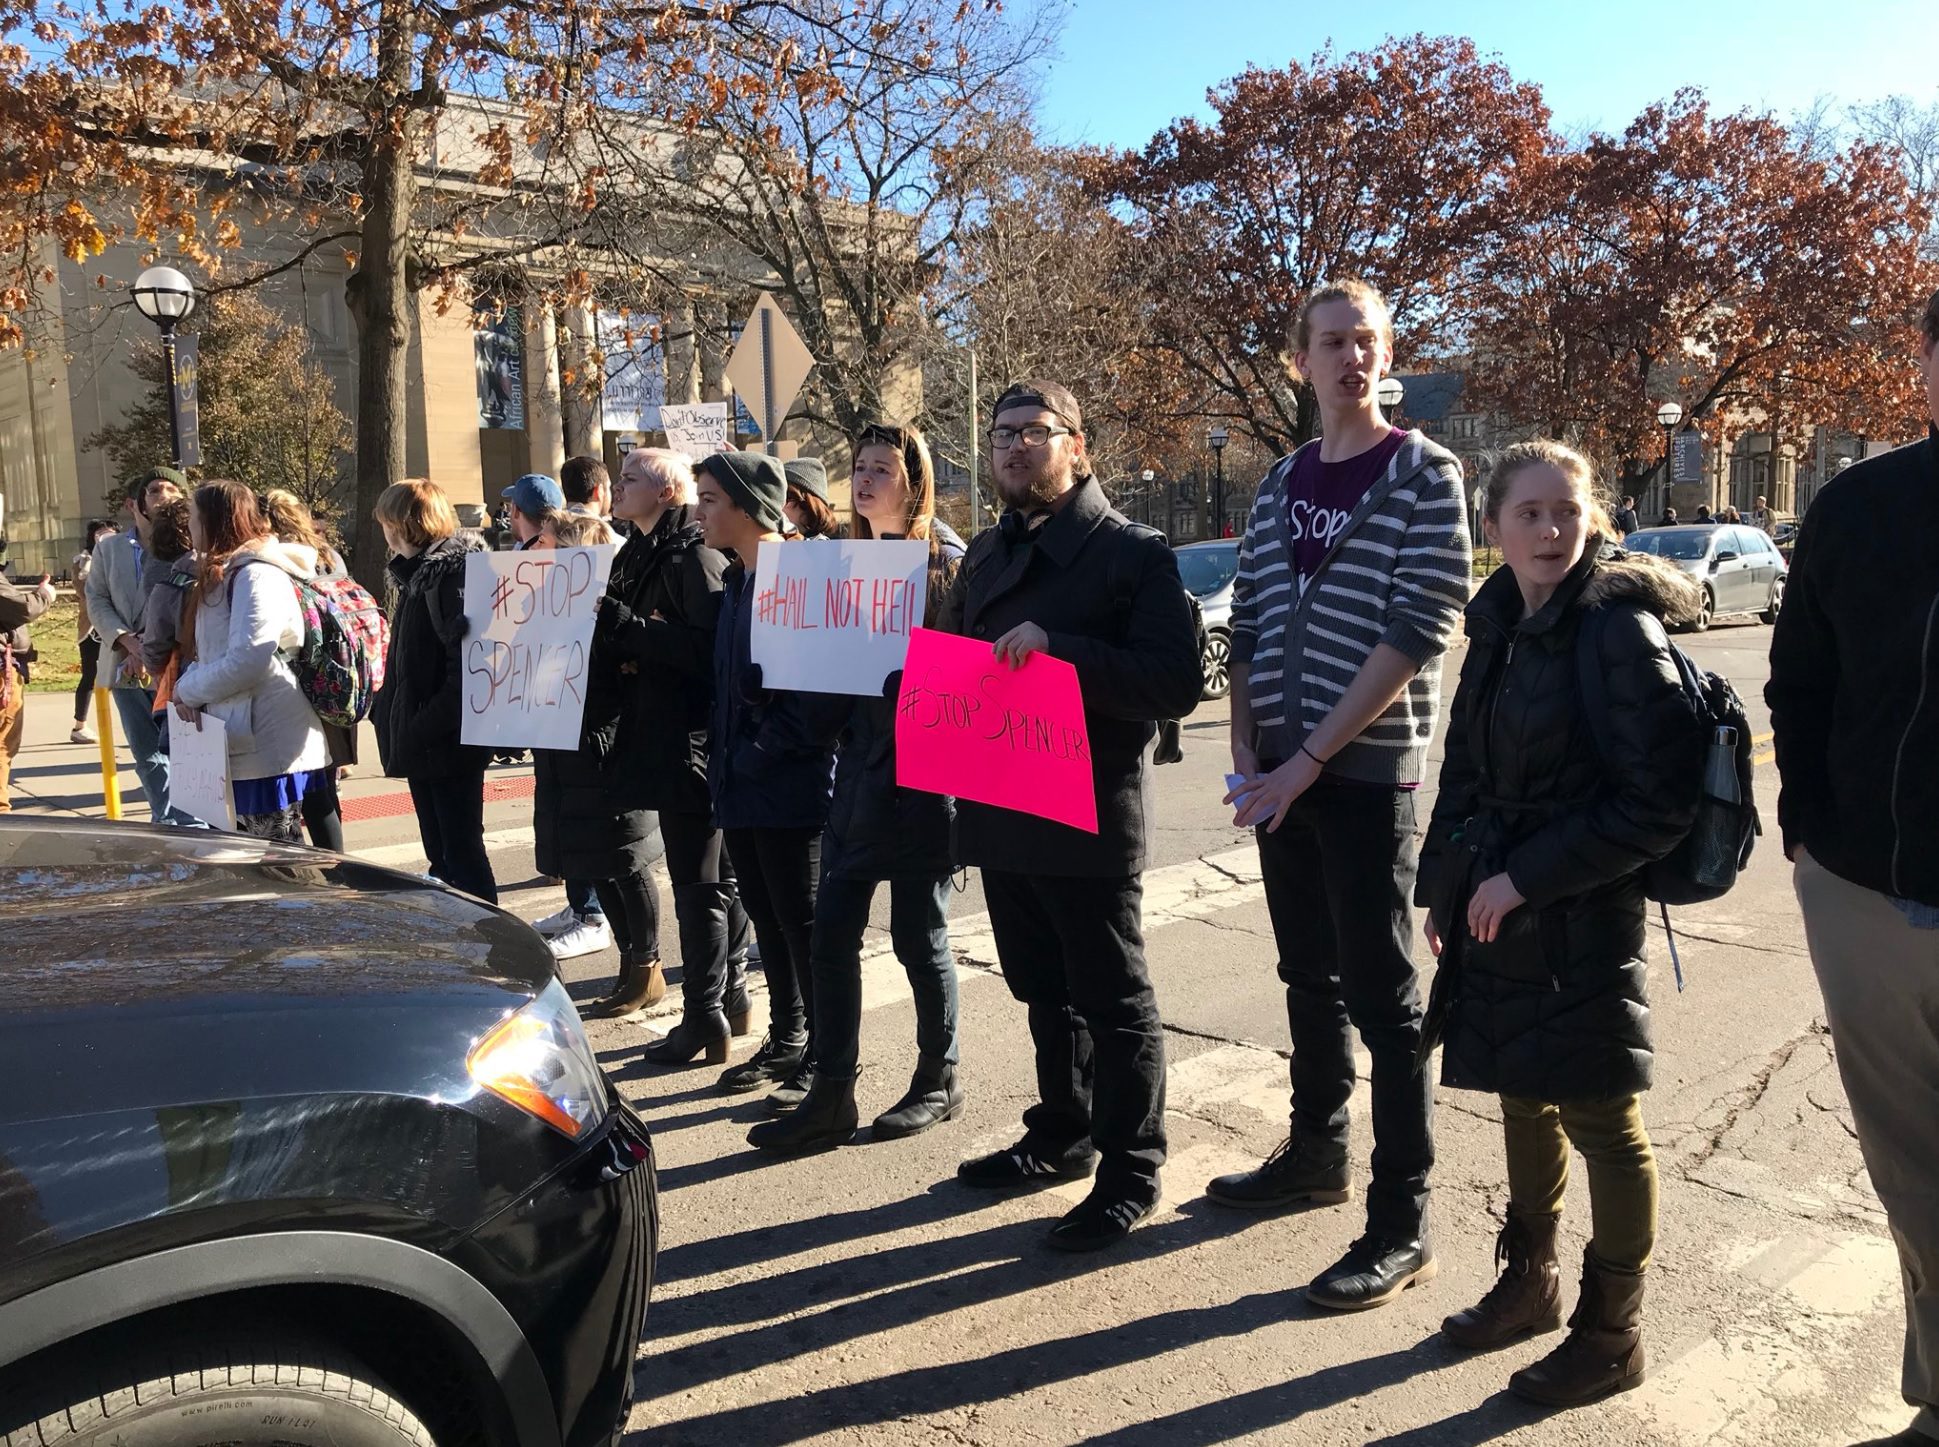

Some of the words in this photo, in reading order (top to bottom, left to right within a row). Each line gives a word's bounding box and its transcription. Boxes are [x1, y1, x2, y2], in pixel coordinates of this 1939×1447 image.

[508, 360, 520, 381] Art
[510, 383, 524, 429] African
[686, 410, 726, 428] Observe
[1291, 498, 1352, 548] Stop
[491, 551, 592, 624] #STOP
[758, 574, 818, 630] #HAIL
[826, 577, 864, 629] NOT
[468, 640, 584, 715] SPENCER
[261, 1415, 286, 1425] RUN
